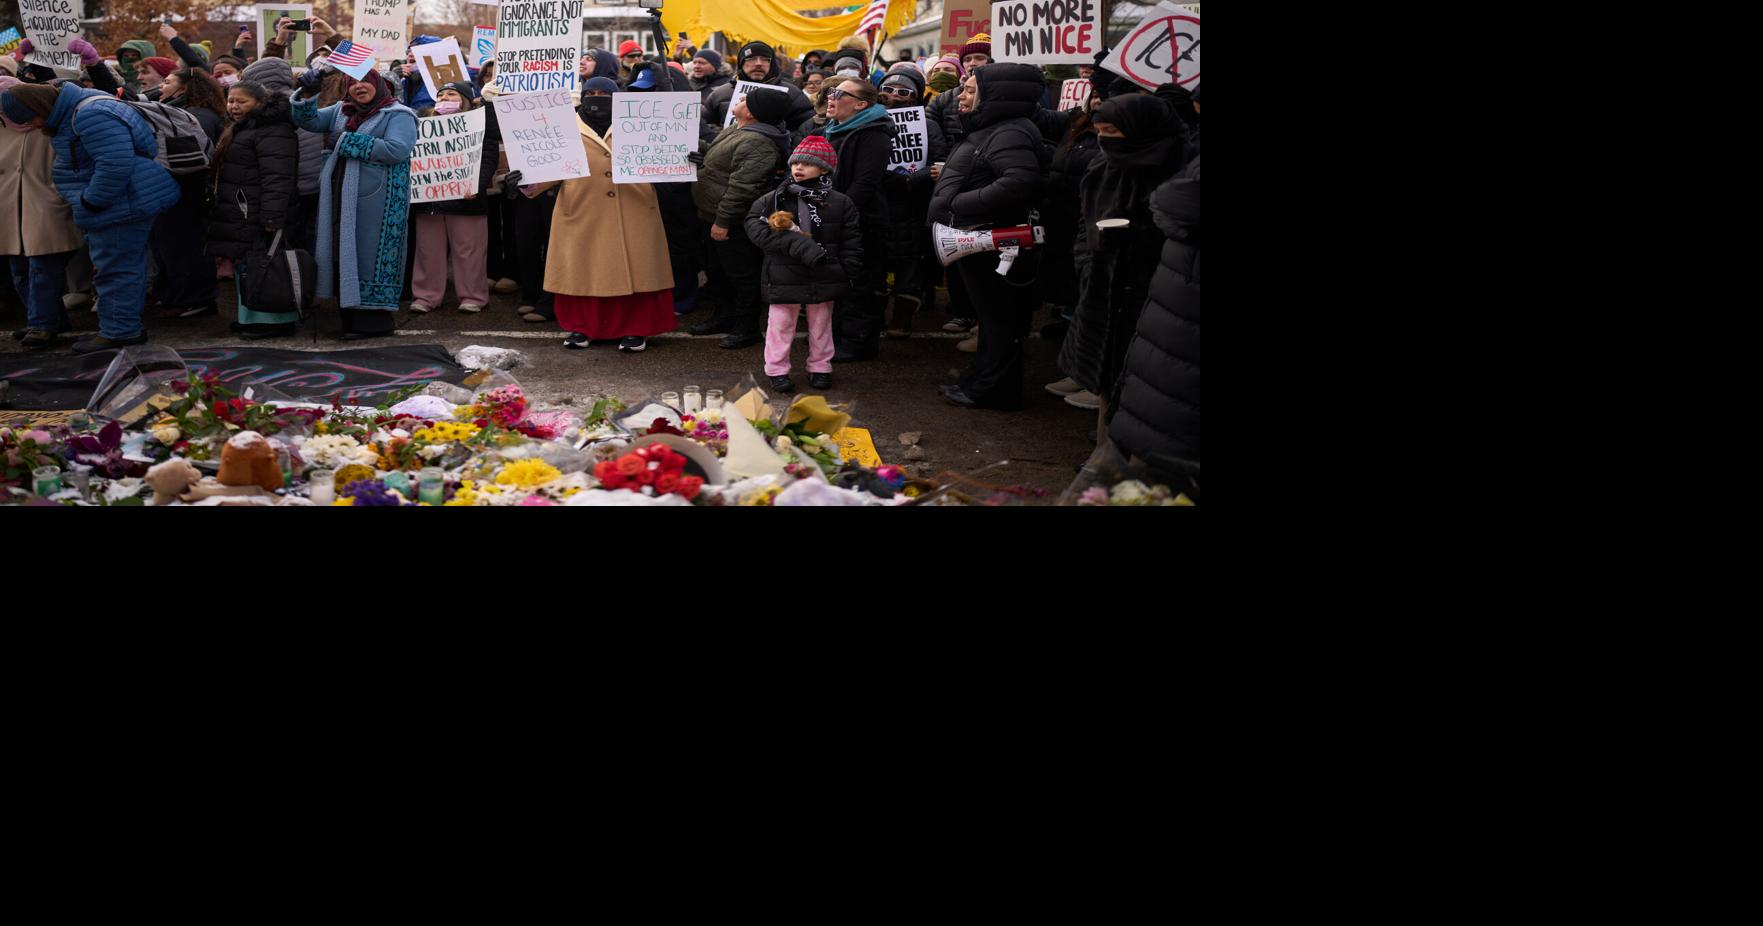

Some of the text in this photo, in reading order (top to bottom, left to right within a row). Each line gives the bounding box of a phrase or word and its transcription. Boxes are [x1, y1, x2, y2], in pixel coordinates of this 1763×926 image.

[501, 0, 584, 20] IGNORANCE NOT
[999, 0, 1094, 27] NO MORE
[361, 28, 400, 40] MY DAD
[500, 19, 569, 38] IMMIGRANTS
[1005, 24, 1092, 56] MN NICE
[498, 47, 575, 62] STOP PRETENDING
[499, 60, 572, 73] YOUR RACISM IS
[496, 72, 575, 92] PATRIOTISM
[498, 92, 572, 114] JUSTICE
[619, 100, 702, 119] ICE GET
[448, 115, 468, 134] ARE
[532, 113, 548, 124] 4
[622, 121, 688, 133] OUT OF MN
[521, 138, 568, 153] NICOLE
[648, 133, 668, 143] AND
[621, 144, 650, 154] STOP
[889, 148, 923, 165] OOD
[527, 152, 562, 167] GOOD
[617, 154, 631, 166] SO
[620, 166, 637, 176] ME
